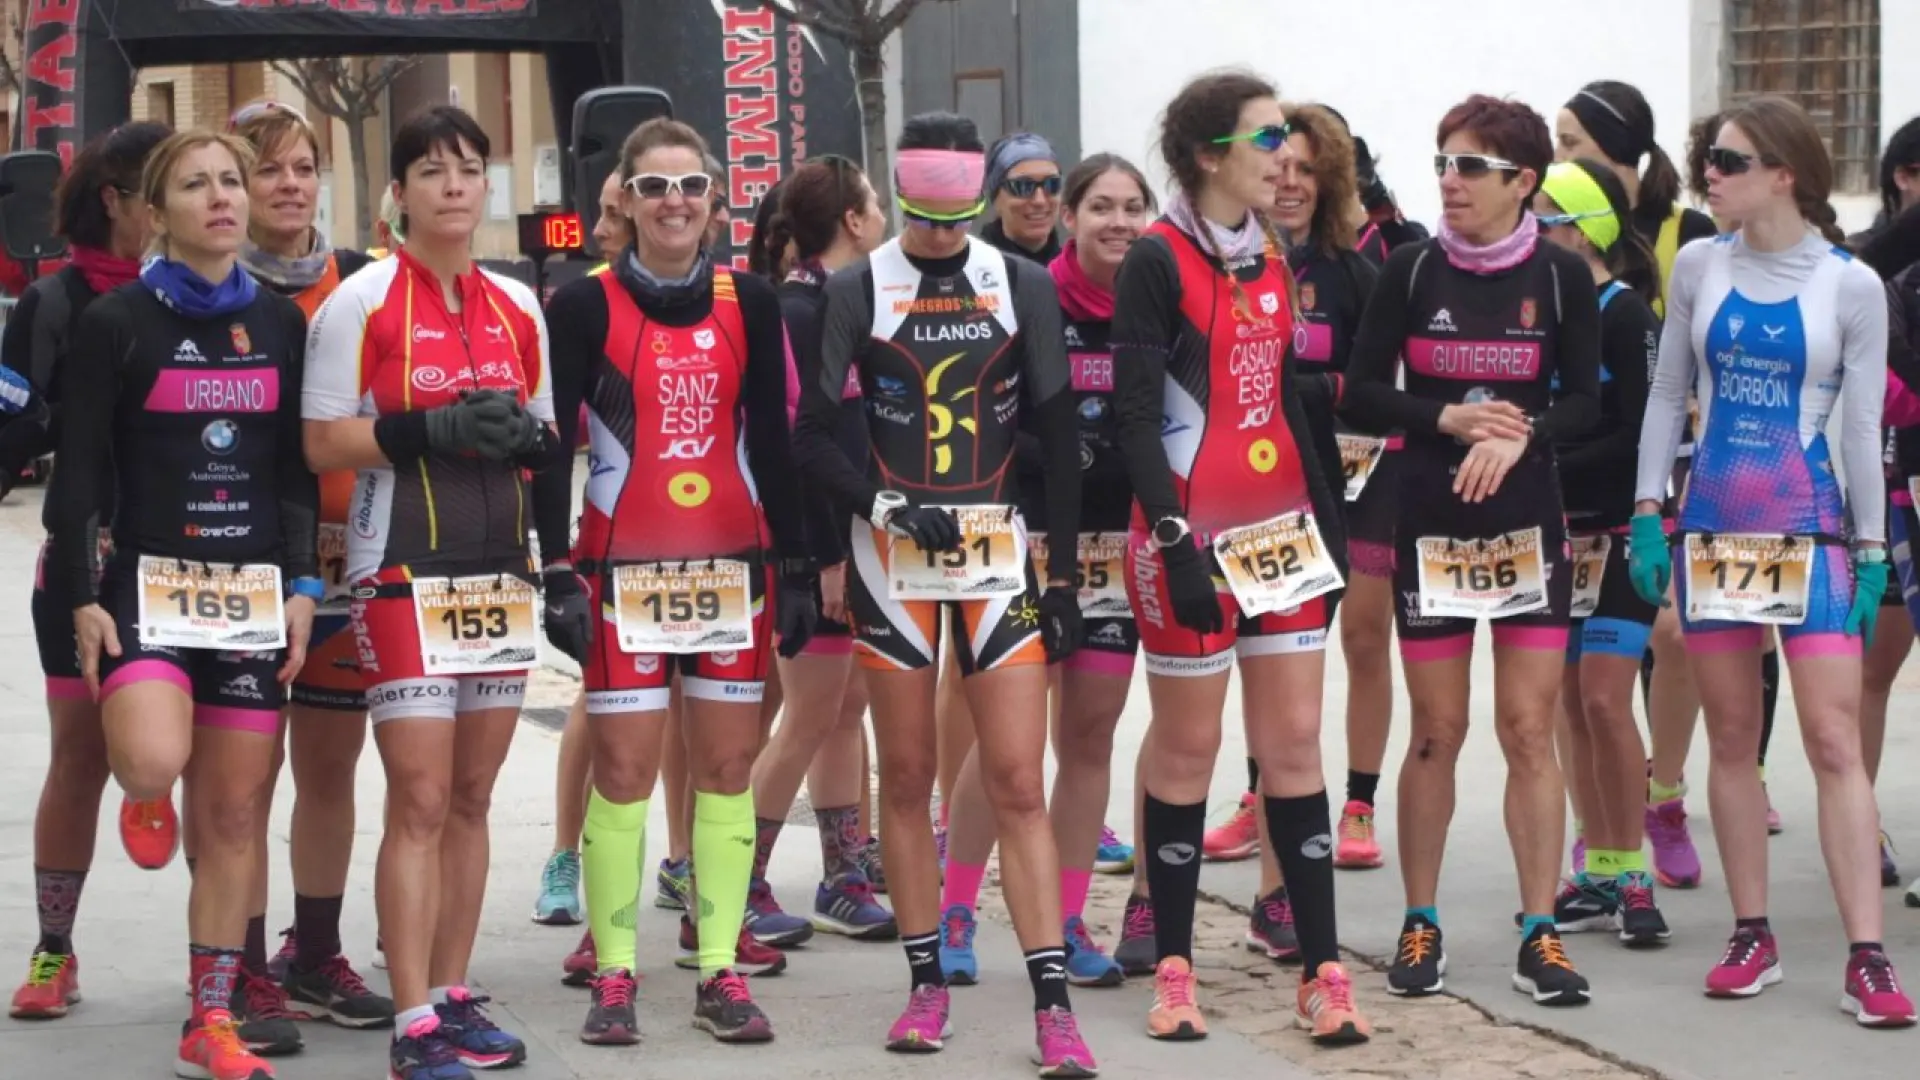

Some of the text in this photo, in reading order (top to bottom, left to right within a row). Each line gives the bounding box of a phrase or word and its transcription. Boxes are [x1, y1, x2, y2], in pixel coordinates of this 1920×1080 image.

[723, 7, 781, 273] INME
[914, 322, 992, 341] LLANOS
[1230, 338, 1281, 376] CASADO
[1432, 345, 1534, 375] GUTIERREZ
[185, 378, 264, 410] URBANO
[657, 372, 719, 405] SANZ
[1238, 372, 1274, 404] ESP
[1719, 369, 1789, 408] BORBÓN
[660, 406, 714, 434] ESP
[1241, 544, 1304, 582] 152
[1444, 559, 1517, 591] 166
[1710, 561, 1781, 593] 171
[146, 575, 195, 591] VILLA
[621, 578, 668, 592] VILLA
[672, 578, 692, 590] DE
[167, 589, 250, 622] 169
[420, 593, 460, 608] VILLA
[463, 593, 483, 606] DE
[642, 591, 720, 622] 159
[442, 607, 508, 640] 153
